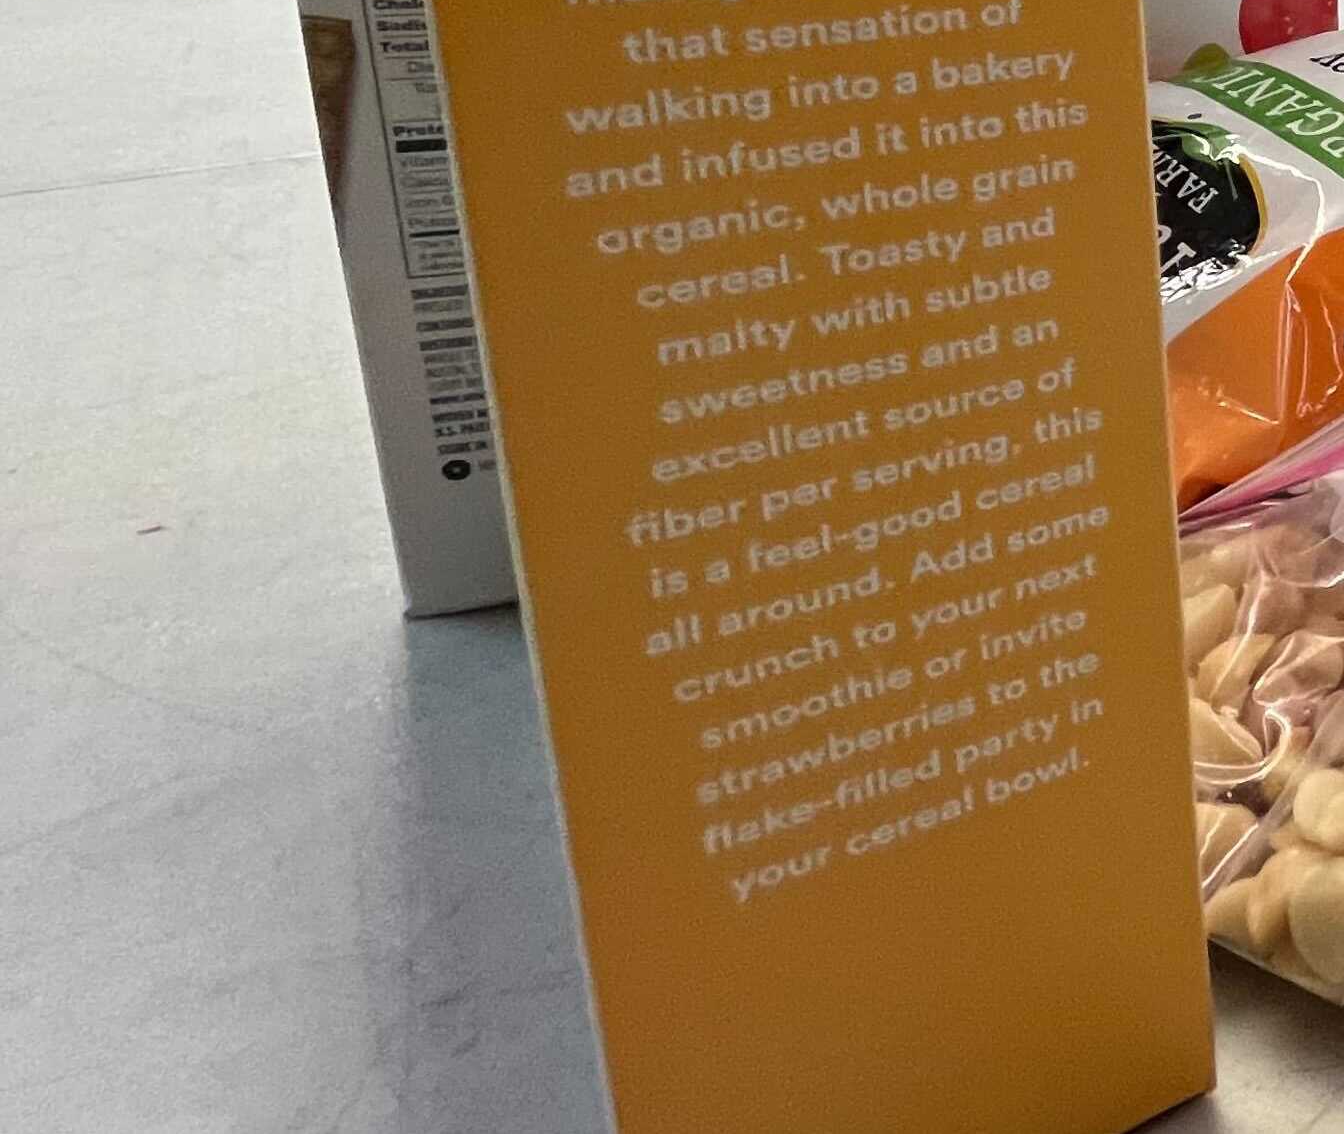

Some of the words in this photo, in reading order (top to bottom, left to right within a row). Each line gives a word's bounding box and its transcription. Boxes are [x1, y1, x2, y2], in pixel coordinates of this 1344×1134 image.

[565, 85, 772, 135] walking
[788, 73, 879, 110] into
[894, 71, 918, 96] a
[933, 50, 1075, 89] bakery
[623, 27, 727, 65] that
[745, 1, 967, 52] sensation
[565, 159, 664, 199] and
[680, 127, 861, 183] infused
[877, 121, 908, 155] it
[921, 113, 1002, 150] into
[1014, 99, 1089, 134] this
[596, 200, 806, 256] organic,
[821, 176, 959, 222] whole
[973, 154, 1076, 203] grain
[636, 255, 806, 310] cereal.
[821, 227, 966, 276] Toasty
[982, 207, 1057, 248] and
[657, 315, 797, 365] malty
[811, 292, 911, 335] with
[926, 266, 1053, 313] subtle
[651, 410, 869, 482] excellent
[884, 379, 1025, 430] source
[1036, 358, 1078, 392] of
[659, 351, 908, 424] sweetness
[922, 325, 999, 368] and
[1012, 317, 1060, 348] an
[623, 497, 745, 546] fiber
[760, 477, 838, 521] per
[851, 432, 1022, 491] serving,
[1033, 405, 1104, 444] this
[650, 568, 688, 600] is
[704, 561, 731, 584] a
[747, 491, 962, 573] feel-good
[976, 454, 1097, 511] cereal
[645, 617, 701, 656] all
[718, 567, 896, 637] around.
[909, 535, 993, 581] Add
[1006, 505, 1109, 553] some
[673, 631, 839, 702] crunch
[852, 621, 896, 651] to
[910, 586, 1003, 640] your
[1014, 553, 1098, 600] next
[696, 694, 976, 804] strawberries
[989, 676, 1027, 708] to
[1039, 651, 1099, 689] the
[700, 666, 912, 750] smoothie
[925, 649, 966, 680] or
[980, 608, 1088, 660] invite
[702, 751, 941, 853] flake-filled
[954, 714, 1059, 771] party
[1070, 696, 1104, 725] in
[730, 845, 832, 905] your
[846, 790, 974, 856] cereal
[987, 748, 1091, 804] bowl.
